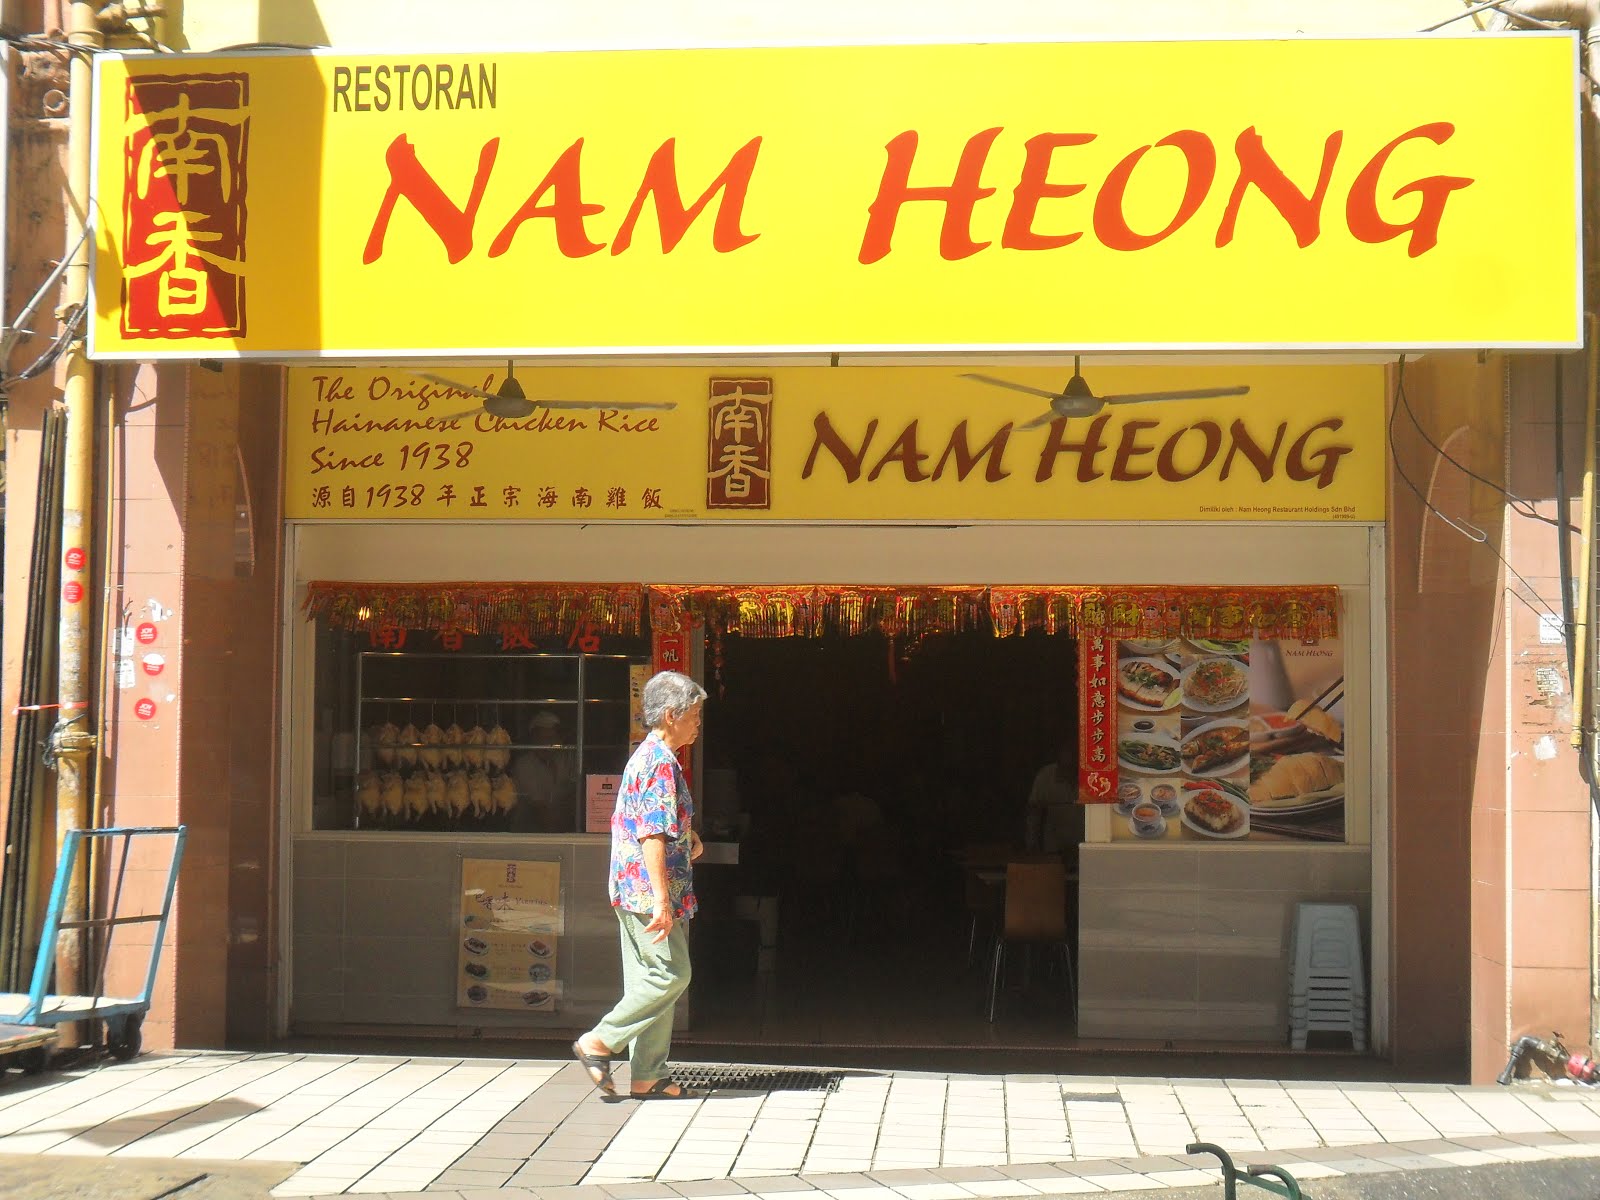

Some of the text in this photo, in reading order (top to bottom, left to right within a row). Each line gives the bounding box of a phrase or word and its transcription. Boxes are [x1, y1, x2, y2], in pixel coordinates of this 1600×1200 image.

[333, 62, 497, 112] RESTORAN
[362, 121, 1475, 265] NAM HEONG
[312, 373, 495, 411] The Original
[311, 408, 661, 436] Hainanese Chicken Rice
[311, 441, 475, 475] Since 1938
[801, 411, 1353, 490] NAM HEONG
[1252, 506, 1271, 514] Heong
[1304, 506, 1330, 514] Holdings
